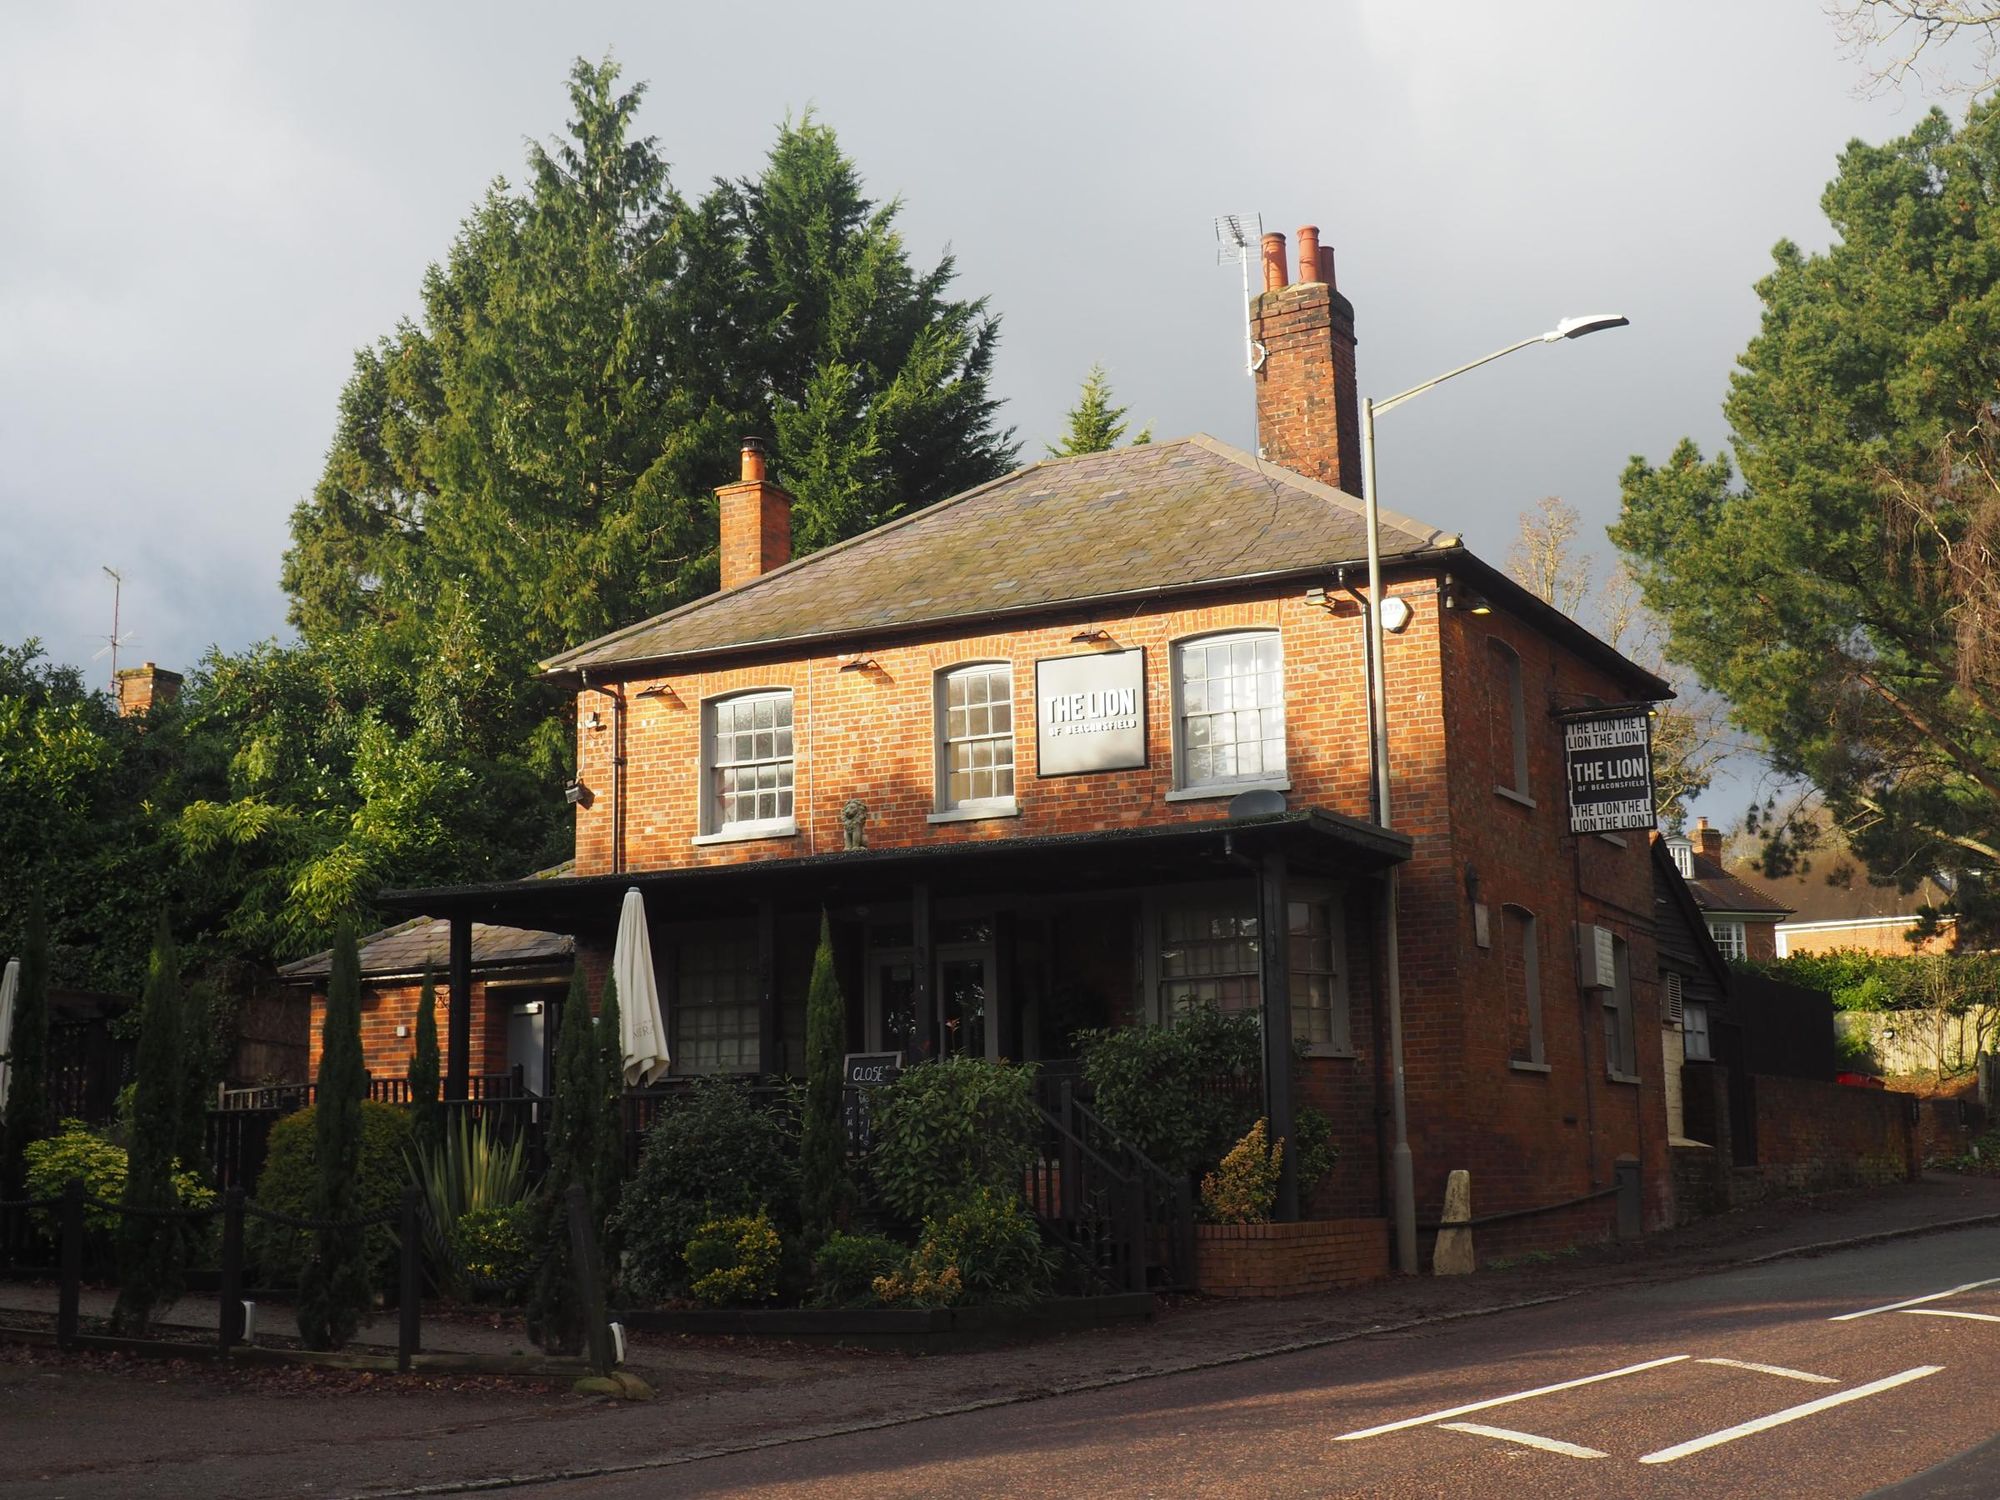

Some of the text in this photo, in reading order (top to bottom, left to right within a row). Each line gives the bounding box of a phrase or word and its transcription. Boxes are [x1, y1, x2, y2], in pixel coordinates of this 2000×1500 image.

[1044, 687, 1136, 723] THE LION
[1048, 727, 1062, 737] OF
[1592, 719, 1615, 733] LION
[1568, 736, 1591, 749] LION
[1593, 733, 1613, 746] THE
[1615, 731, 1639, 744] LION
[1573, 757, 1644, 782] THE LION
[1591, 780, 1645, 791] BEACONSFIELD
[1575, 805, 1594, 817] THE
[1596, 802, 1620, 815] LION
[1621, 801, 1640, 813] THE
[1574, 818, 1596, 831] LION
[1599, 816, 1618, 829] THE
[1621, 814, 1645, 827] LION
[853, 1065, 890, 1082] CLOSE
